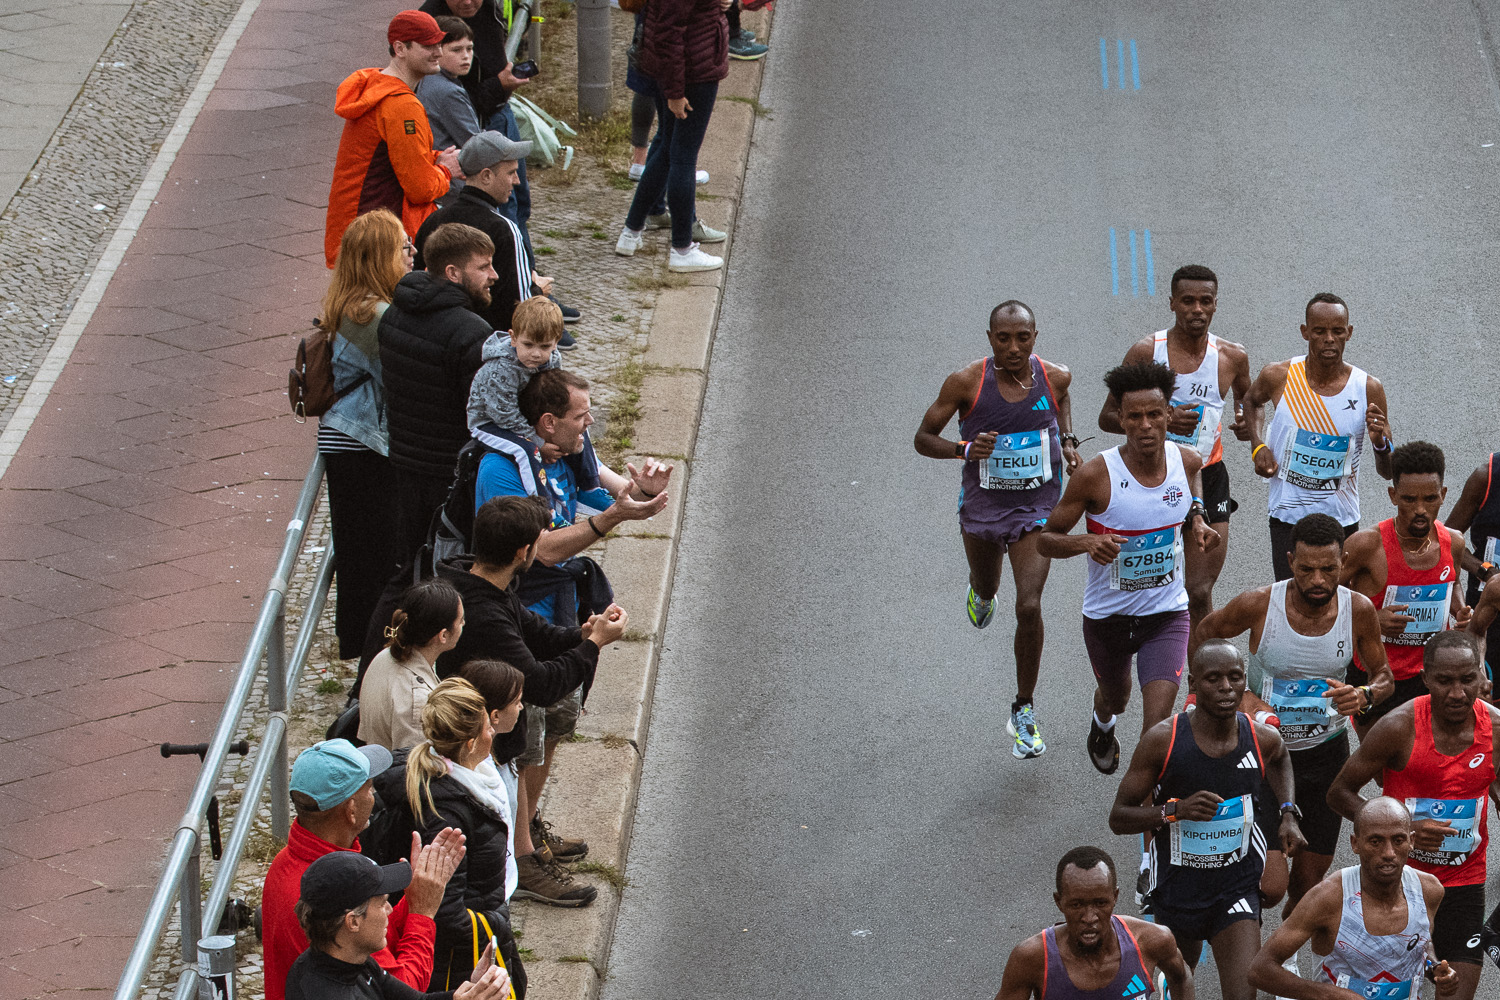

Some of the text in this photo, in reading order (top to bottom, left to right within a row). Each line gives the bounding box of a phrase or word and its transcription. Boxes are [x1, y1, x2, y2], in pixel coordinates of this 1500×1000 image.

[993, 454, 1039, 468] TEKLU
[1293, 451, 1344, 470] TSEGAY
[990, 477, 1026, 485] IMPOSSIBLE
[1288, 471, 1322, 484] IMPOSSIBLE
[1293, 478, 1320, 490] NOTHING
[1124, 548, 1173, 568] 67884
[1134, 566, 1165, 577] Samuel
[1120, 576, 1158, 586] IMPOSSIBLE
[1128, 582, 1157, 591] NOTHING
[1393, 638, 1422, 646] NOTHING
[1272, 704, 1327, 715] ABRAHAM
[1279, 725, 1309, 733] OSSIBLE
[1183, 827, 1242, 841] KIPCHUMBA
[1182, 852, 1224, 862] IMPOSSIBLE
[1415, 854, 1448, 865] NOTHING
